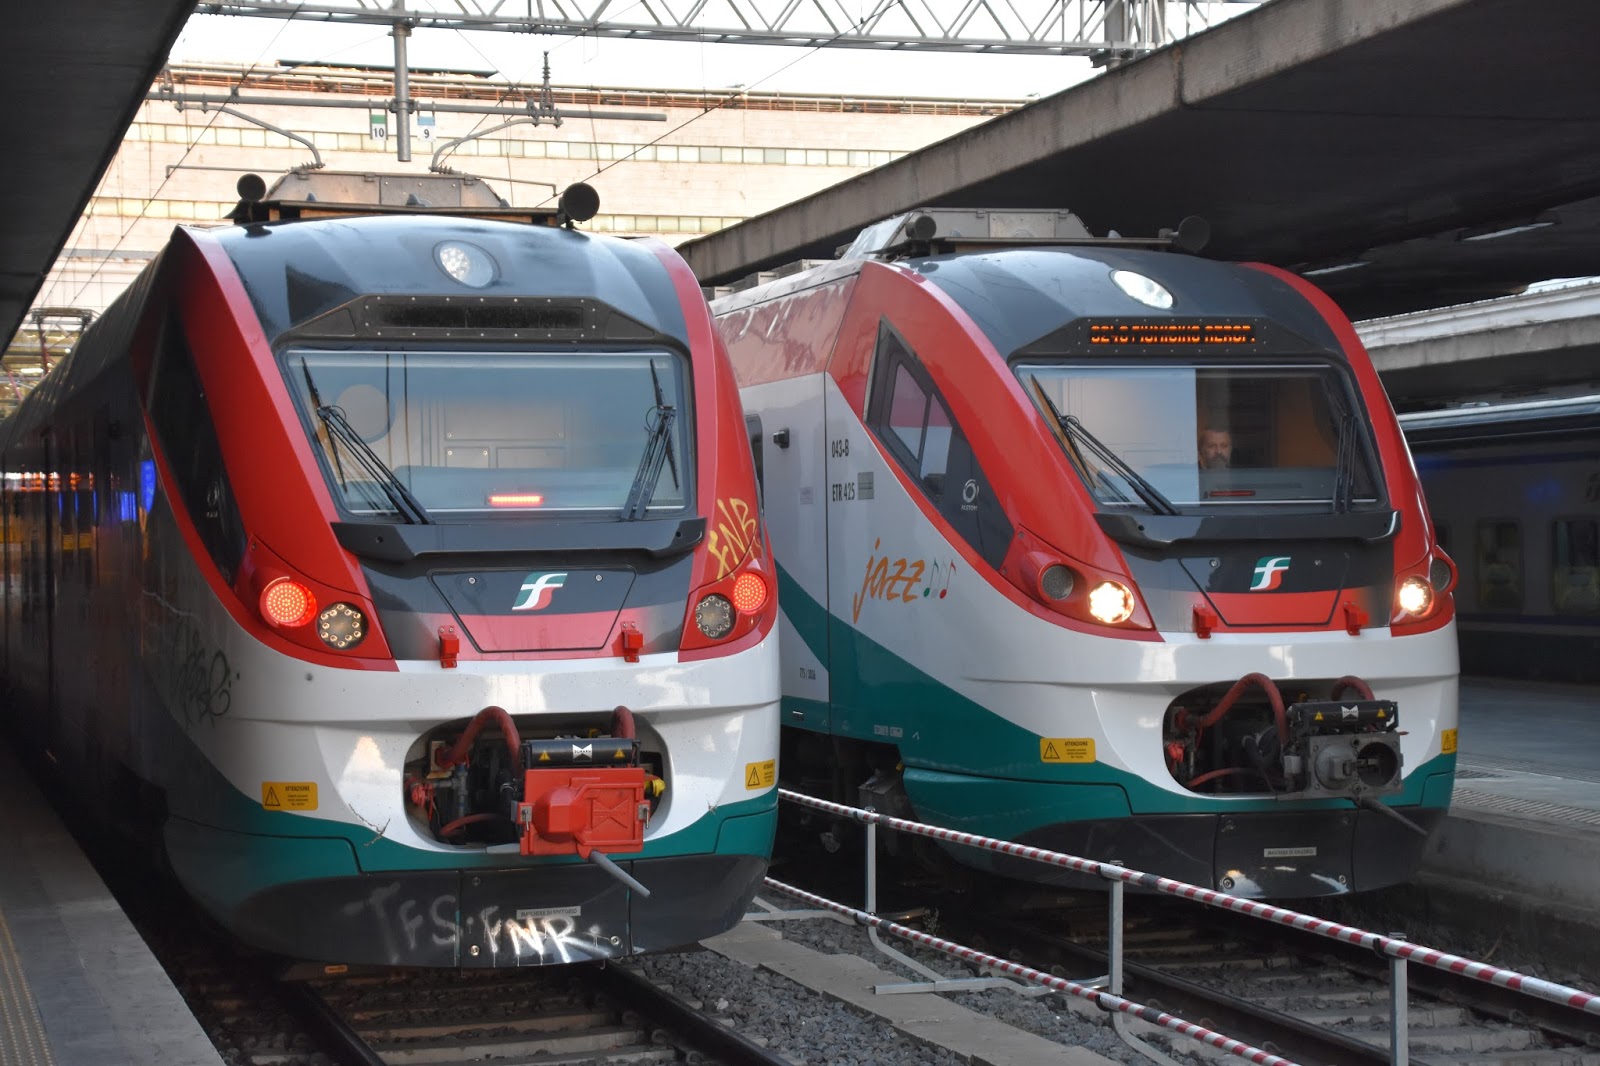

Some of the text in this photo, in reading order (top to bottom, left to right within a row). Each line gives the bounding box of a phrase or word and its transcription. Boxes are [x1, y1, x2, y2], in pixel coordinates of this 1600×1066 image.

[374, 128, 385, 138] 10
[423, 129, 430, 139] 9
[832, 484, 843, 501] ETR
[844, 482, 855, 500] 425
[852, 536, 925, 625] jazz
